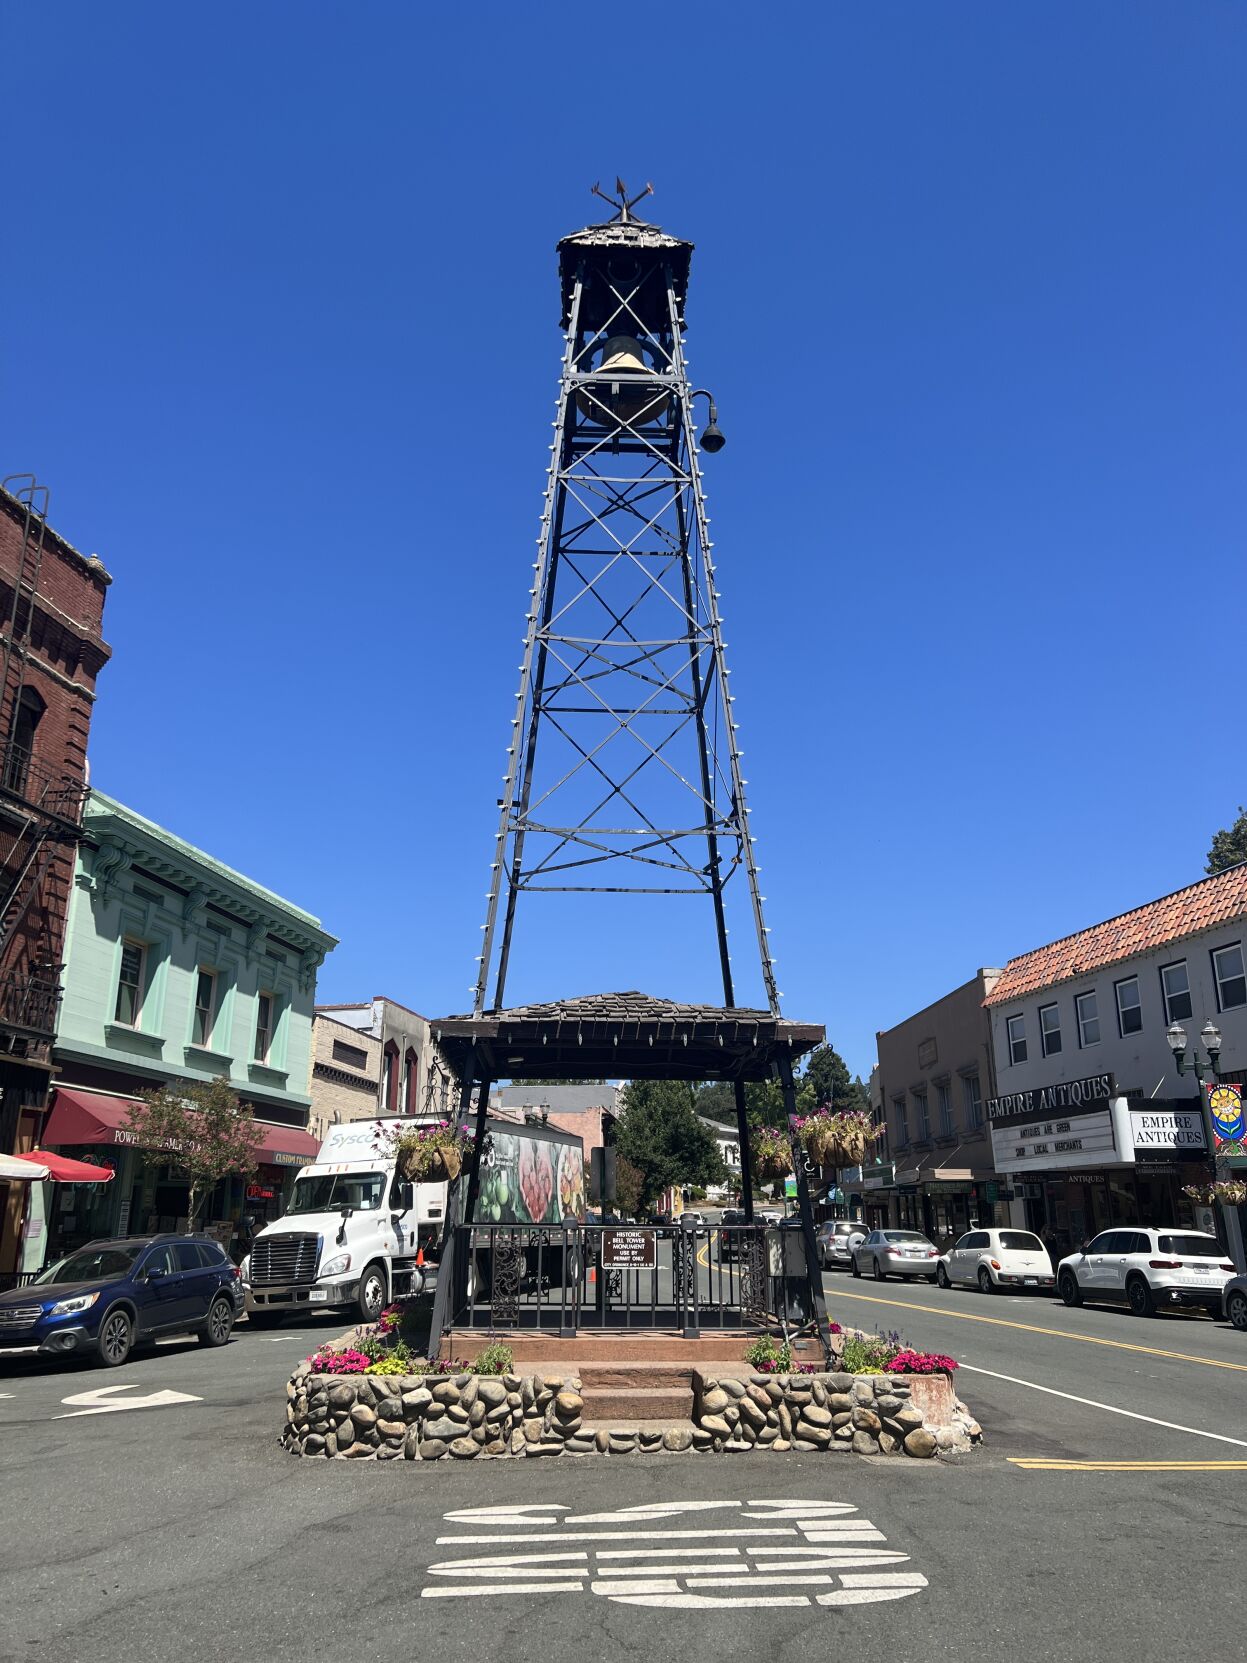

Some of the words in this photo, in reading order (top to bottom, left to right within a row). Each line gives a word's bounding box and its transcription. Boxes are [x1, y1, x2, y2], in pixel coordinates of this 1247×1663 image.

[988, 1092, 1034, 1118] EMPIRE
[1040, 1076, 1111, 1110] ANTIQUES
[1141, 1116, 1192, 1128] EMPIRE
[1020, 1128, 1041, 1138] ANTIQUES
[1044, 1125, 1053, 1135] ARE
[1056, 1122, 1071, 1132] GREEN
[330, 1134, 375, 1148] Sysco
[1136, 1131, 1202, 1145] ANTIQUES
[1015, 1147, 1025, 1157] SHOP
[1033, 1144, 1048, 1154] LOCAL
[1055, 1140, 1082, 1151] MERCHANTS
[275, 1153, 296, 1164] CUSTOM
[1068, 1175, 1105, 1183] ANTIQUES
[421, 1499, 929, 1608] STOP
